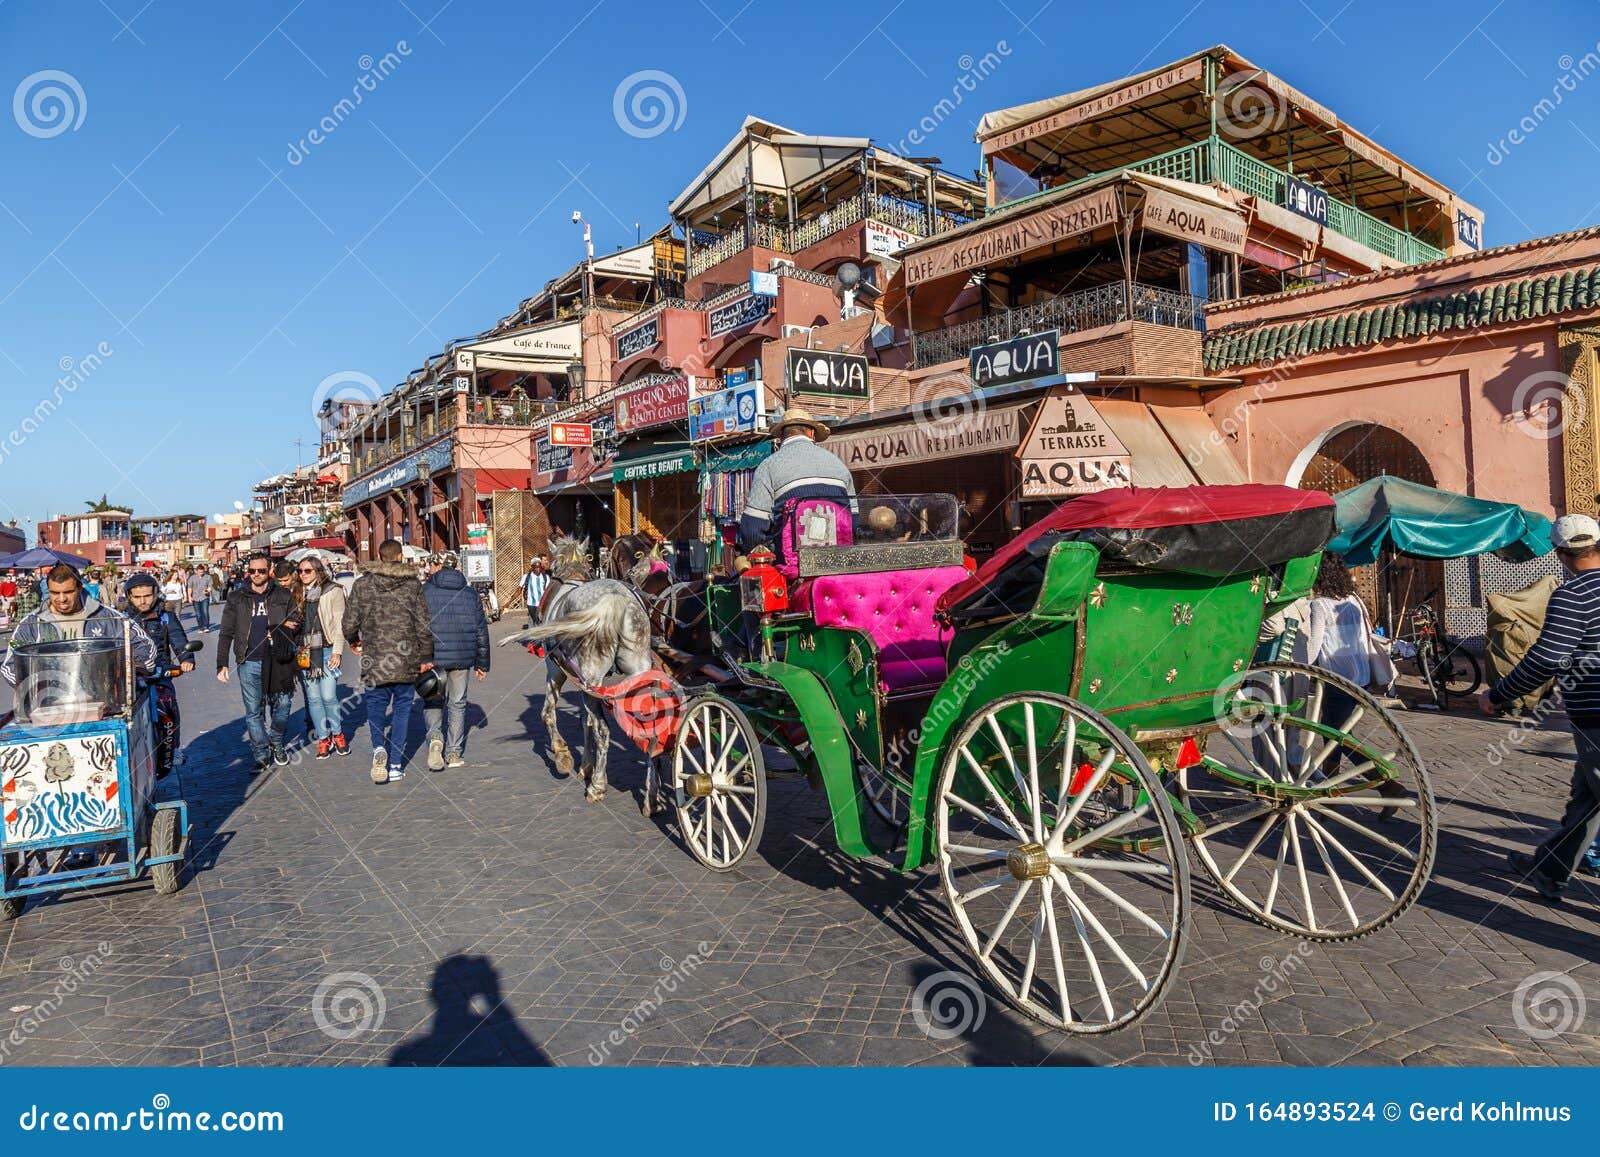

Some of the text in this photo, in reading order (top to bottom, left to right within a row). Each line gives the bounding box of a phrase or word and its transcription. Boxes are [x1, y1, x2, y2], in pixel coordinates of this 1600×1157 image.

[996, 68, 1186, 149] TERRASSE PANORAMIQUE
[1289, 182, 1327, 222] AQUA
[867, 220, 909, 243] GRAND
[872, 233, 889, 243] HOTEL
[952, 230, 1029, 270] RESTAURANT
[1051, 204, 1113, 239] PIZZERIA
[1166, 211, 1207, 236] AQUA
[1209, 227, 1244, 247] RESTAURANT
[513, 340, 532, 350] Café
[545, 341, 572, 350] France
[795, 357, 864, 390] AQUA
[975, 341, 1053, 381] AQUA
[629, 381, 688, 409] LES CINQ SENS
[658, 402, 687, 419] CENTER
[851, 422, 1011, 463] AQUA RESTAURANT
[1040, 435, 1107, 450] TERRASSE
[624, 464, 648, 478] CENTRE
[1024, 461, 1129, 487] AQUA
